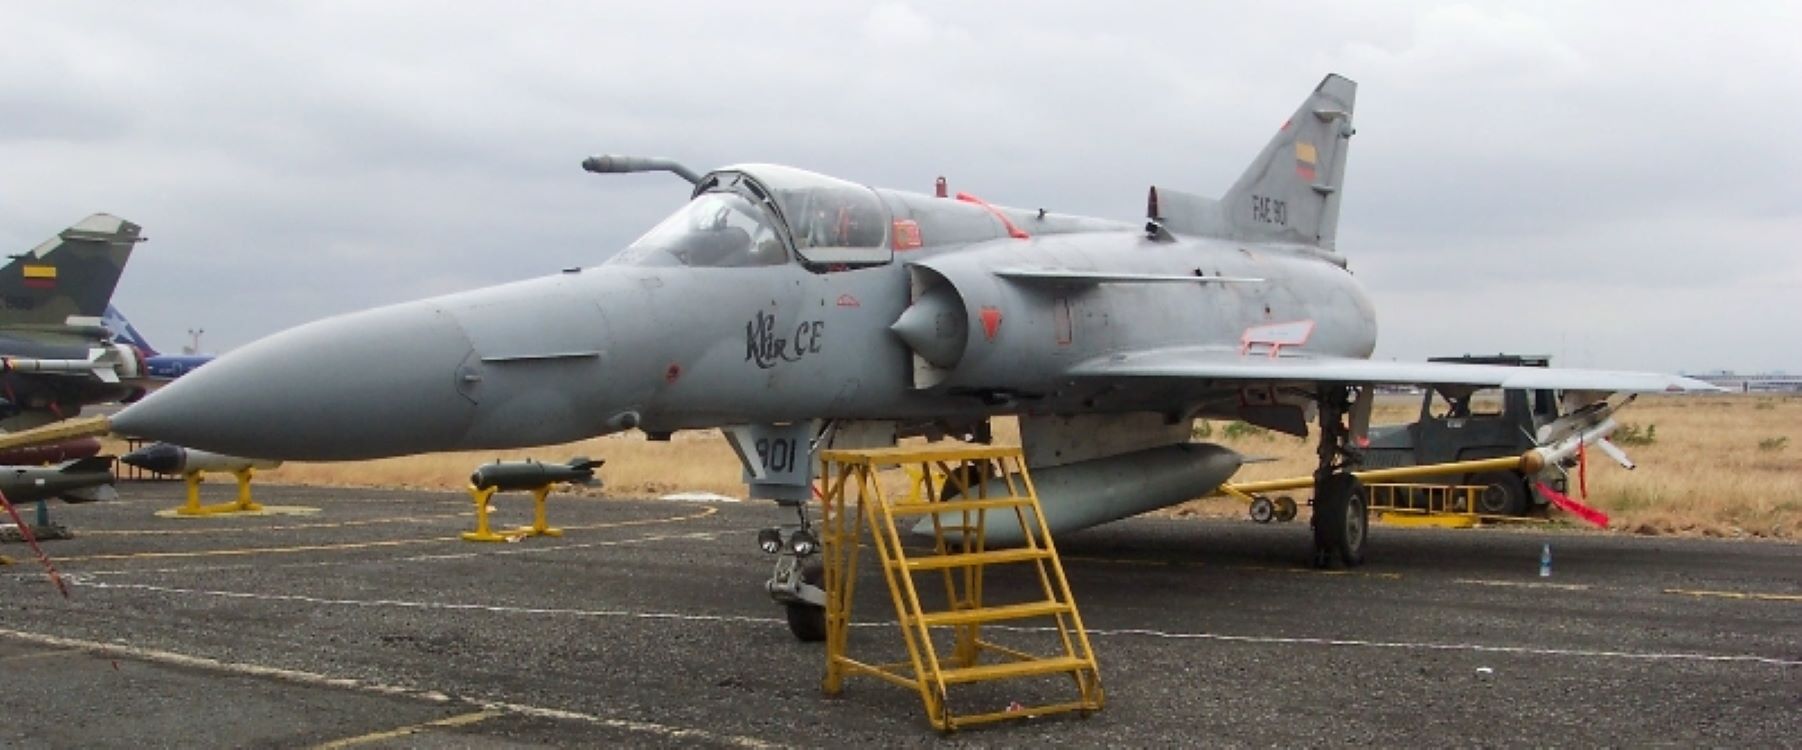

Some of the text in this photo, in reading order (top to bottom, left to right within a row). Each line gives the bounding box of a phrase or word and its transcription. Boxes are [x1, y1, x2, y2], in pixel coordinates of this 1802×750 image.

[1252, 194, 1272, 223] FAE
[794, 320, 825, 356] CE
[756, 438, 797, 473] 901
